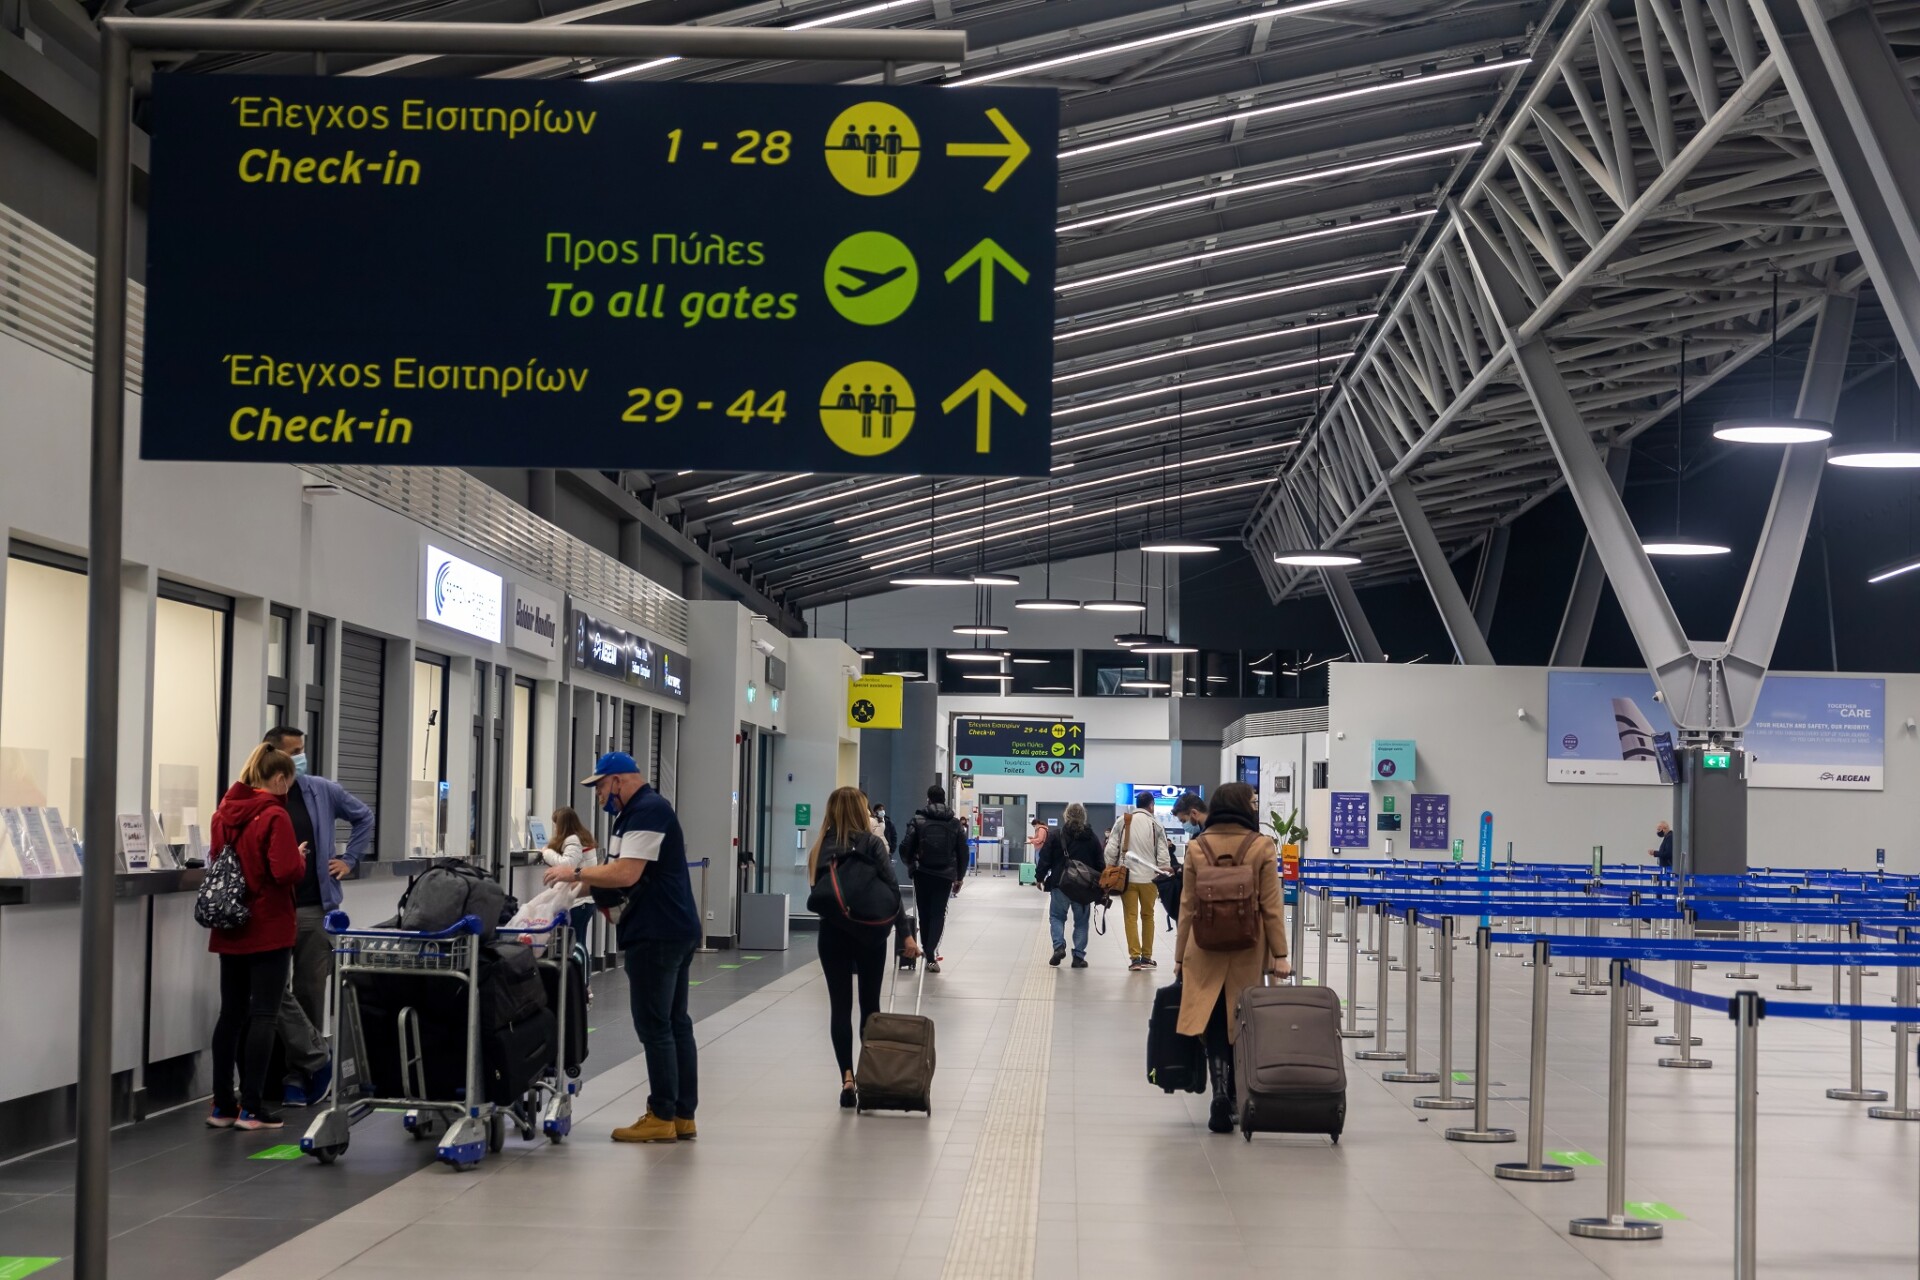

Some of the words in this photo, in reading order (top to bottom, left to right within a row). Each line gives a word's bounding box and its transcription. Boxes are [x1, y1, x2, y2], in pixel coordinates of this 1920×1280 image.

[231, 97, 389, 134] Έλεγχος
[402, 99, 596, 139] Εισιτηρίων
[666, 128, 682, 163] 1
[702, 141, 718, 150] -
[729, 130, 792, 165] 28
[238, 148, 422, 186] Check-in
[545, 232, 640, 270] Προς
[651, 233, 766, 266] Πύλες
[545, 282, 594, 318] To
[607, 283, 665, 319] all
[680, 288, 798, 328] gates
[222, 353, 382, 393] Έλεγχος
[394, 357, 589, 397] Εισιτηρίων
[621, 387, 683, 423] 29
[697, 401, 713, 410] -
[725, 389, 787, 424] 44
[229, 406, 414, 444] Check-in
[1840, 708, 1871, 718] CARE
[1836, 774, 1871, 782] AEGEAN
